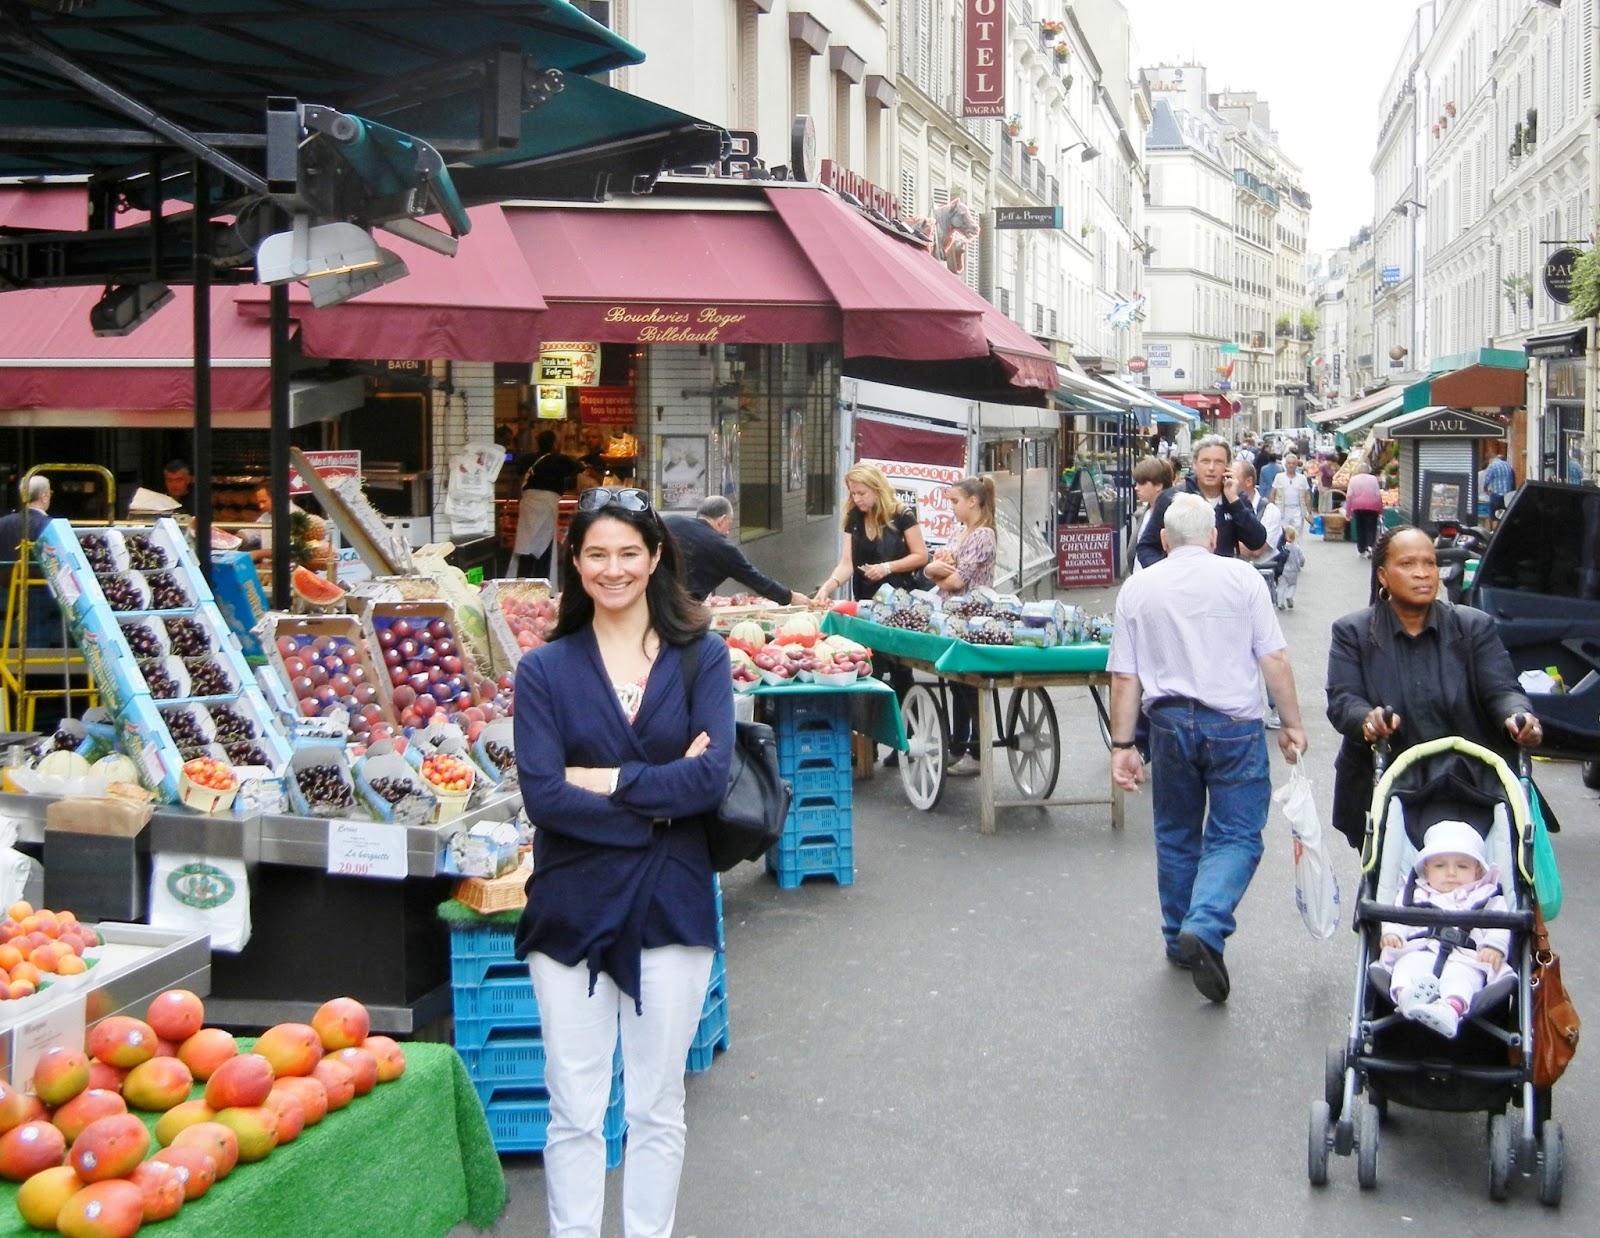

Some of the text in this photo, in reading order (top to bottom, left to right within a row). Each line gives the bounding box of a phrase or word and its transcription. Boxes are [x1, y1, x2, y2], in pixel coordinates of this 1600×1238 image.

[974, 0, 996, 92] OTEL
[965, 106, 1004, 115] WAGRAM
[999, 211, 1015, 222] Jeff
[1023, 210, 1053, 222] Bruges
[604, 306, 746, 328] Boucheries Roger
[637, 325, 719, 342] Billebault
[388, 360, 419, 369] BAYEN
[580, 396, 604, 406] Chaque
[591, 406, 605, 415] tous
[1429, 420, 1467, 431] PAUL
[922, 468, 960, 481] JOUR
[896, 490, 916, 503] aché
[1060, 533, 1110, 542] BOUCHERIE
[1061, 542, 1109, 552] CHEVALINE
[1067, 552, 1103, 560] PRODUITS
[345, 849, 357, 858] La
